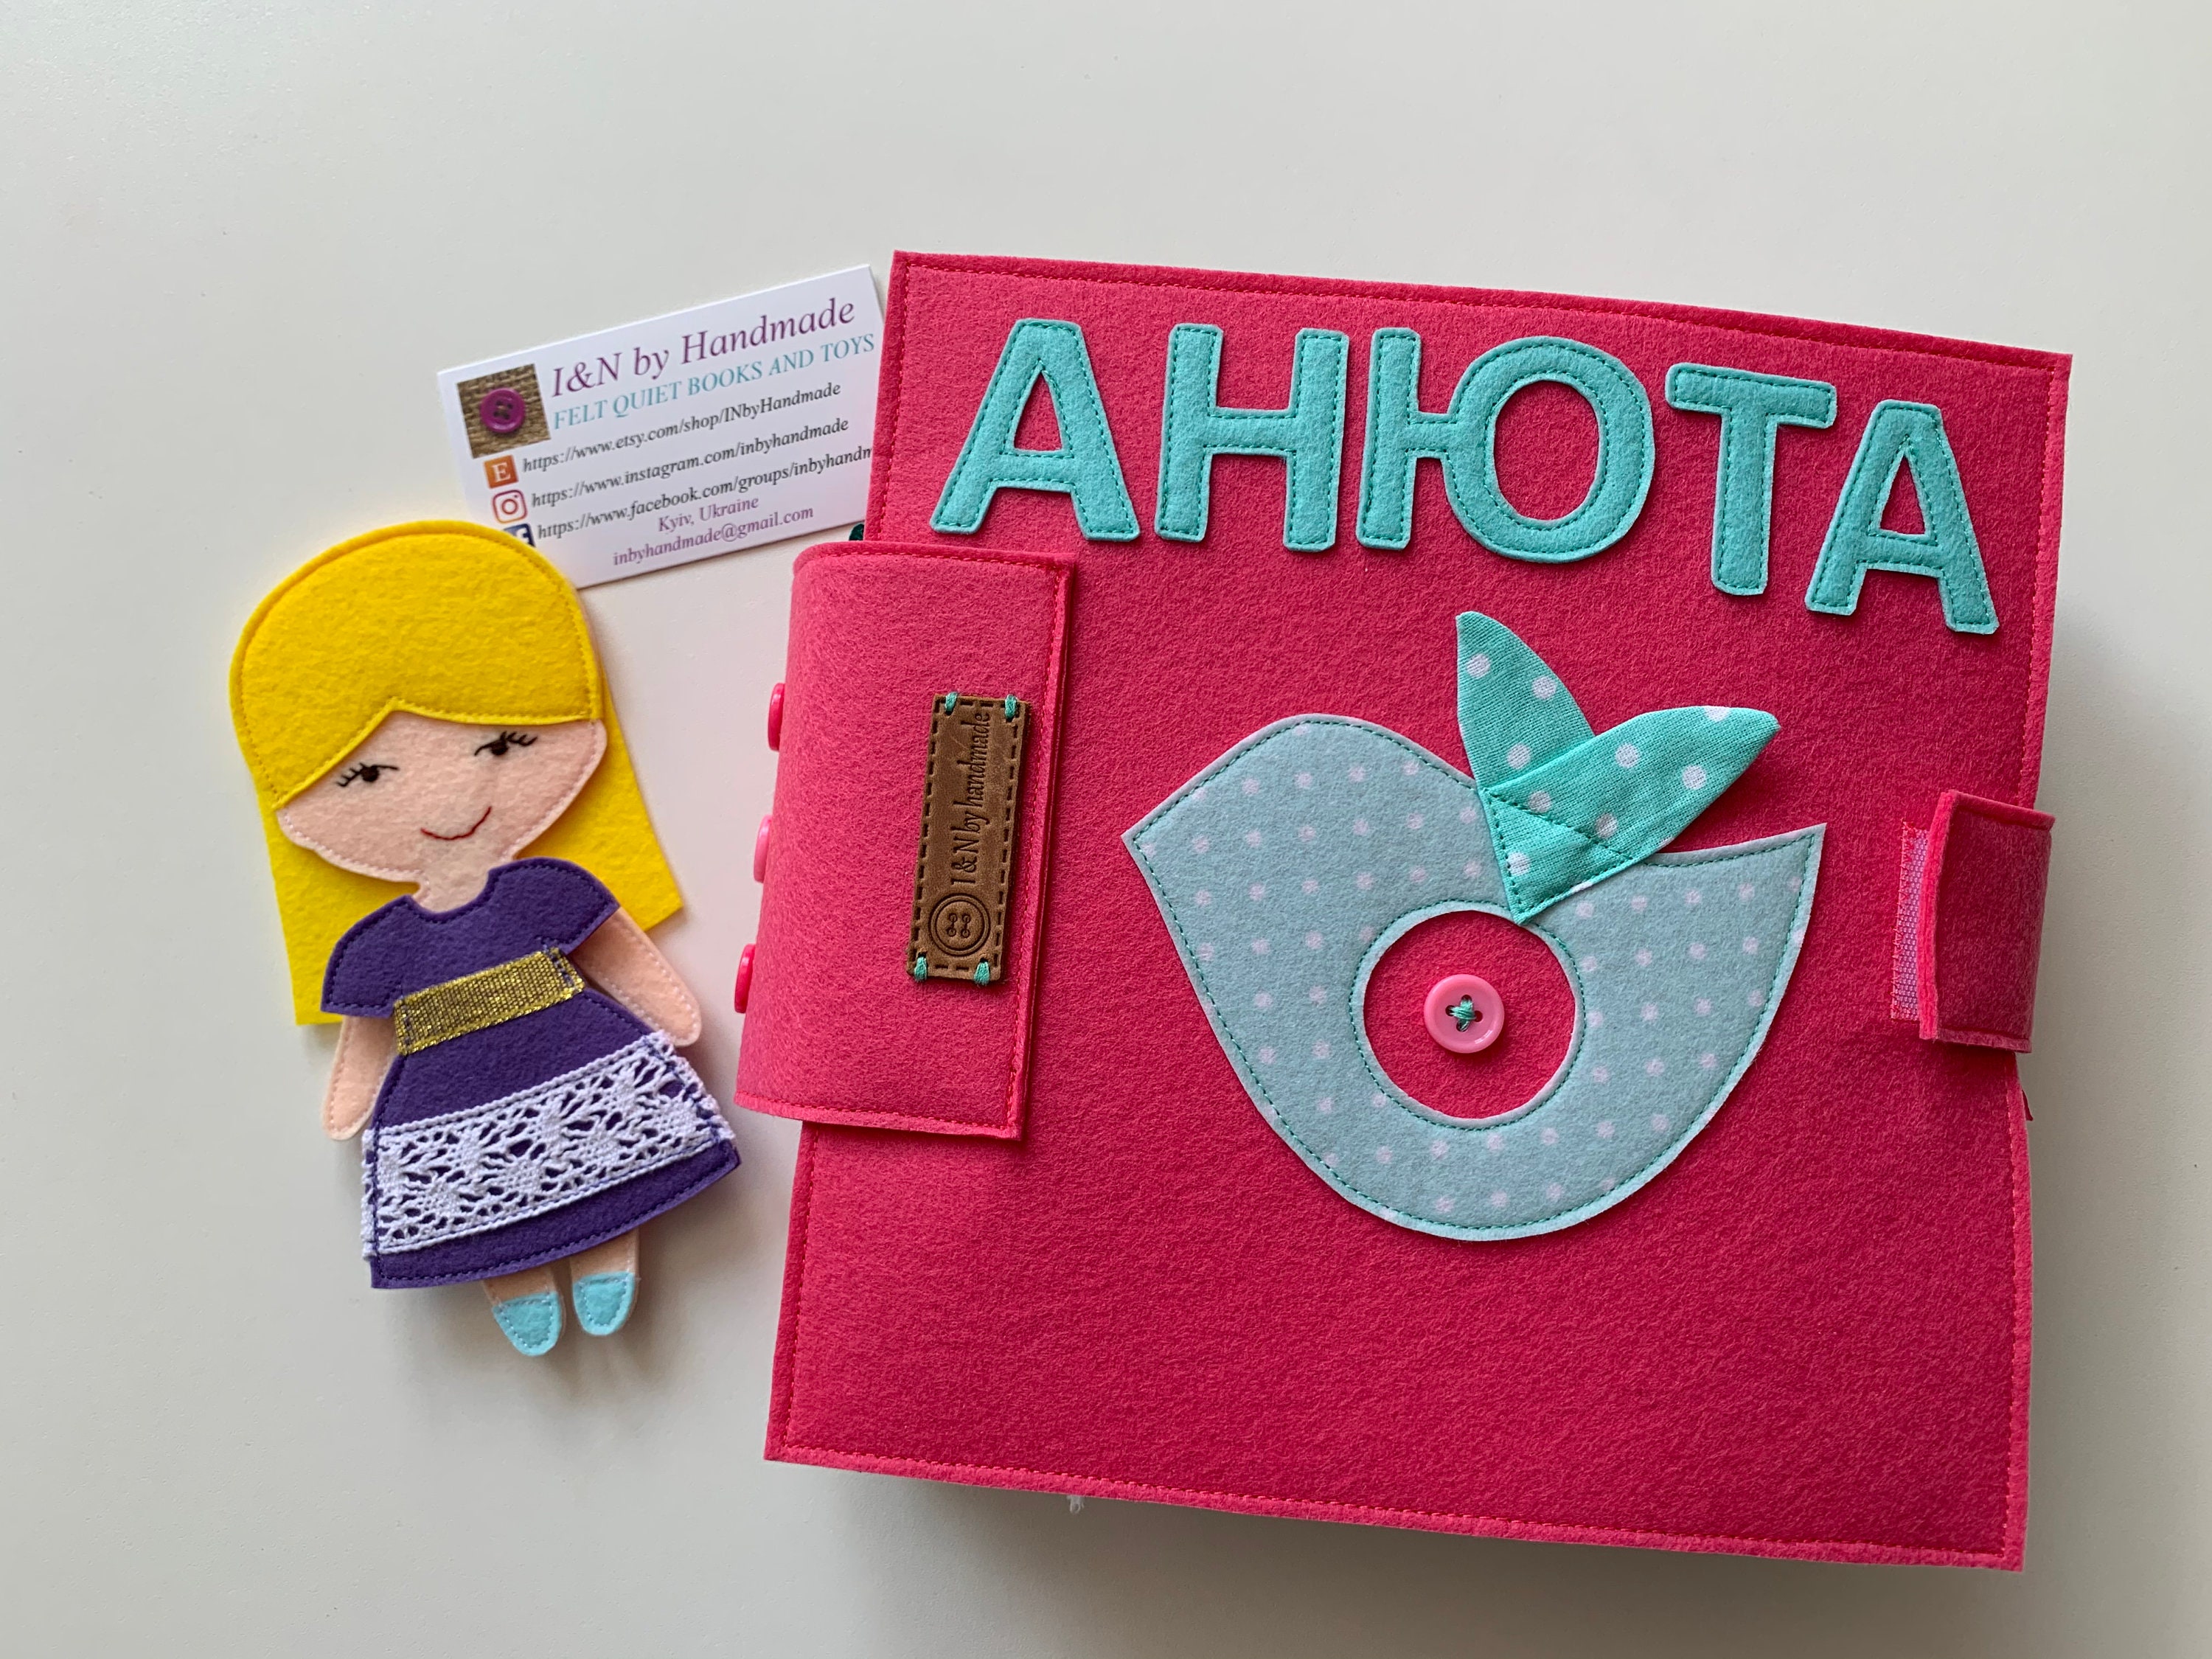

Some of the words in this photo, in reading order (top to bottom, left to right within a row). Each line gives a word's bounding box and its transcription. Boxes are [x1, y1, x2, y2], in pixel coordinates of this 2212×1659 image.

[552, 352, 622, 398] I&N
[632, 347, 669, 380] by
[681, 297, 855, 364] Handmade
[553, 399, 608, 430] FELT
[612, 380, 682, 418] QUIET
[687, 361, 763, 396] BOOKS
[768, 349, 814, 376] AND
[820, 333, 874, 362] TOYS
[522, 382, 841, 473] https://www.etsy.com/shop/INbyHandmade
[531, 417, 849, 507] https://www.instagram.com/inbyhandmade
[658, 512, 695, 535] Kyiv,
[699, 496, 759, 523] Ukraine
[930, 318, 2000, 635] АНЮТА
[613, 507, 814, 566] inbyhandmade@gmail.com
[953, 712, 990, 807] handmade
[950, 811, 990, 834] by
